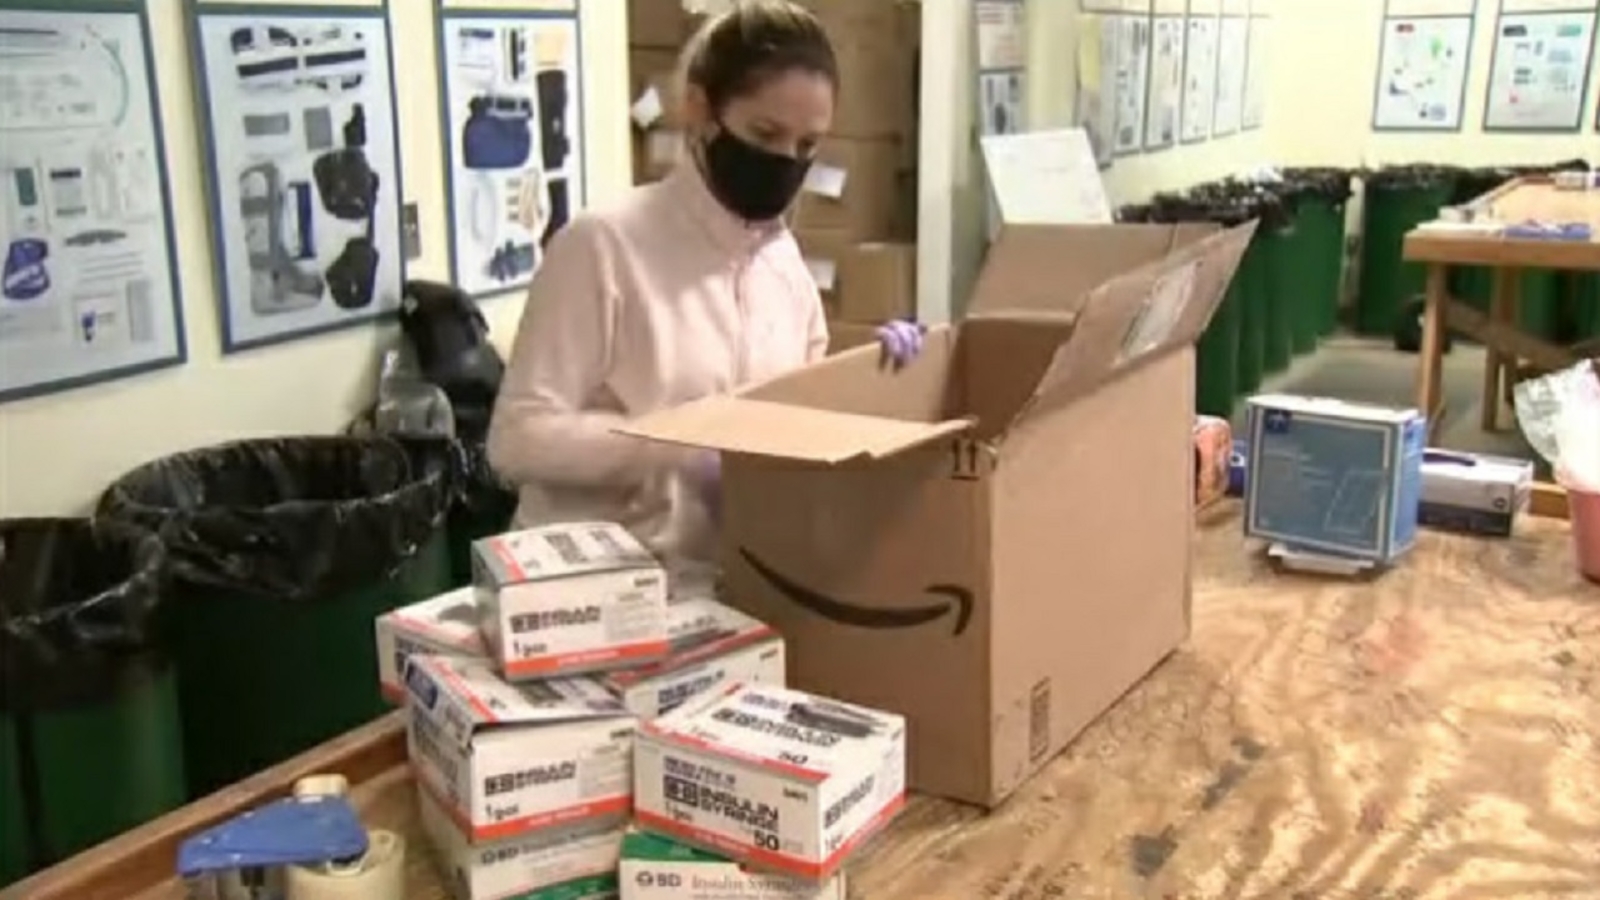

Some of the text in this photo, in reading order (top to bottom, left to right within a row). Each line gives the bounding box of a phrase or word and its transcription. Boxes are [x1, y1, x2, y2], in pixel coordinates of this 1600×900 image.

[701, 799, 779, 832] SYRINGE
[703, 786, 779, 821] INSULIN
[754, 829, 780, 851] 50
[657, 872, 682, 887] BD
